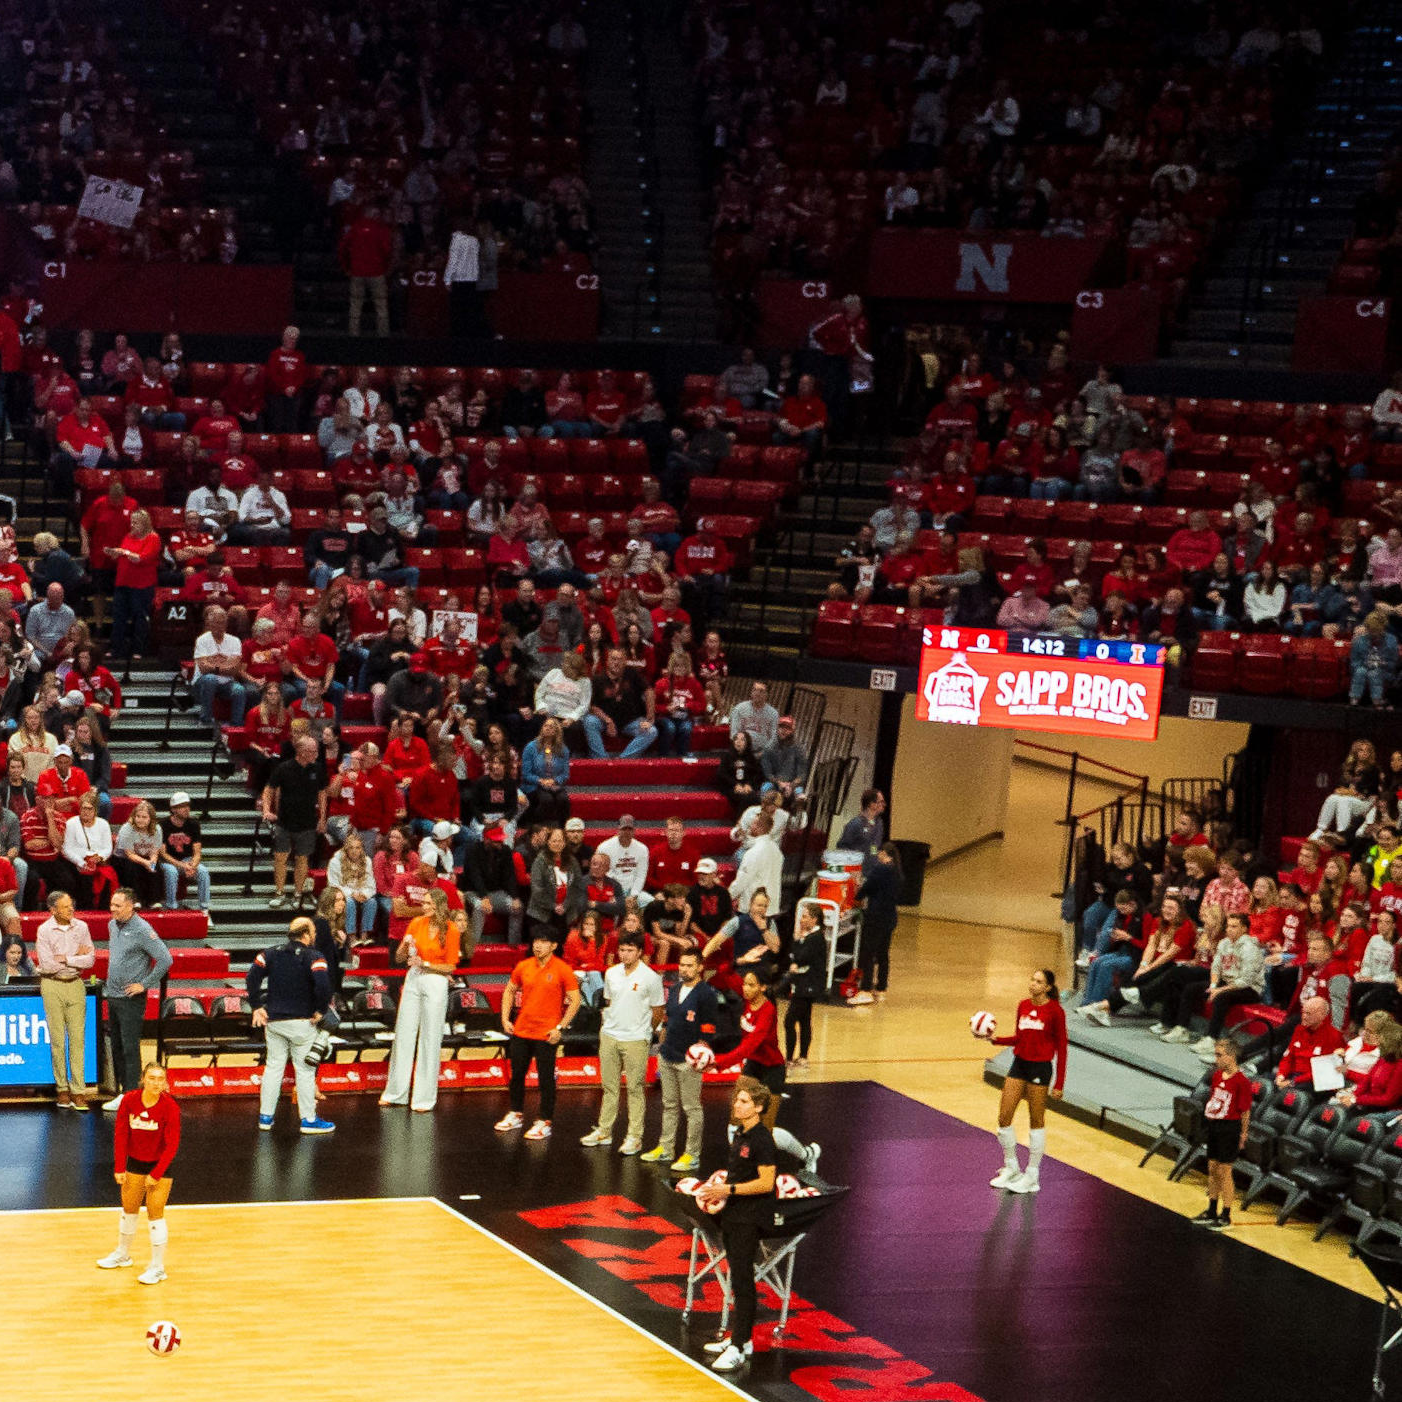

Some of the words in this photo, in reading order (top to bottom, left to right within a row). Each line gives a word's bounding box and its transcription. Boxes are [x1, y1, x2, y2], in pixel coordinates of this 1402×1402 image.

[45, 262, 66, 278] C1
[955, 243, 1012, 293] N
[413, 271, 437, 288] C2
[576, 274, 599, 290] C2
[802, 282, 827, 298] C3
[1076, 292, 1103, 309] C3
[1356, 300, 1385, 318] C4
[167, 606, 186, 620] A2
[940, 630, 959, 648] N
[976, 634, 990, 648] 0
[1022, 638, 1065, 655] 14:12
[1096, 644, 1109, 659] 0
[873, 673, 895, 687] EXIT
[996, 671, 1068, 706] SAPP
[1072, 673, 1149, 720] BROS.
[1192, 699, 1215, 715] EXIT
